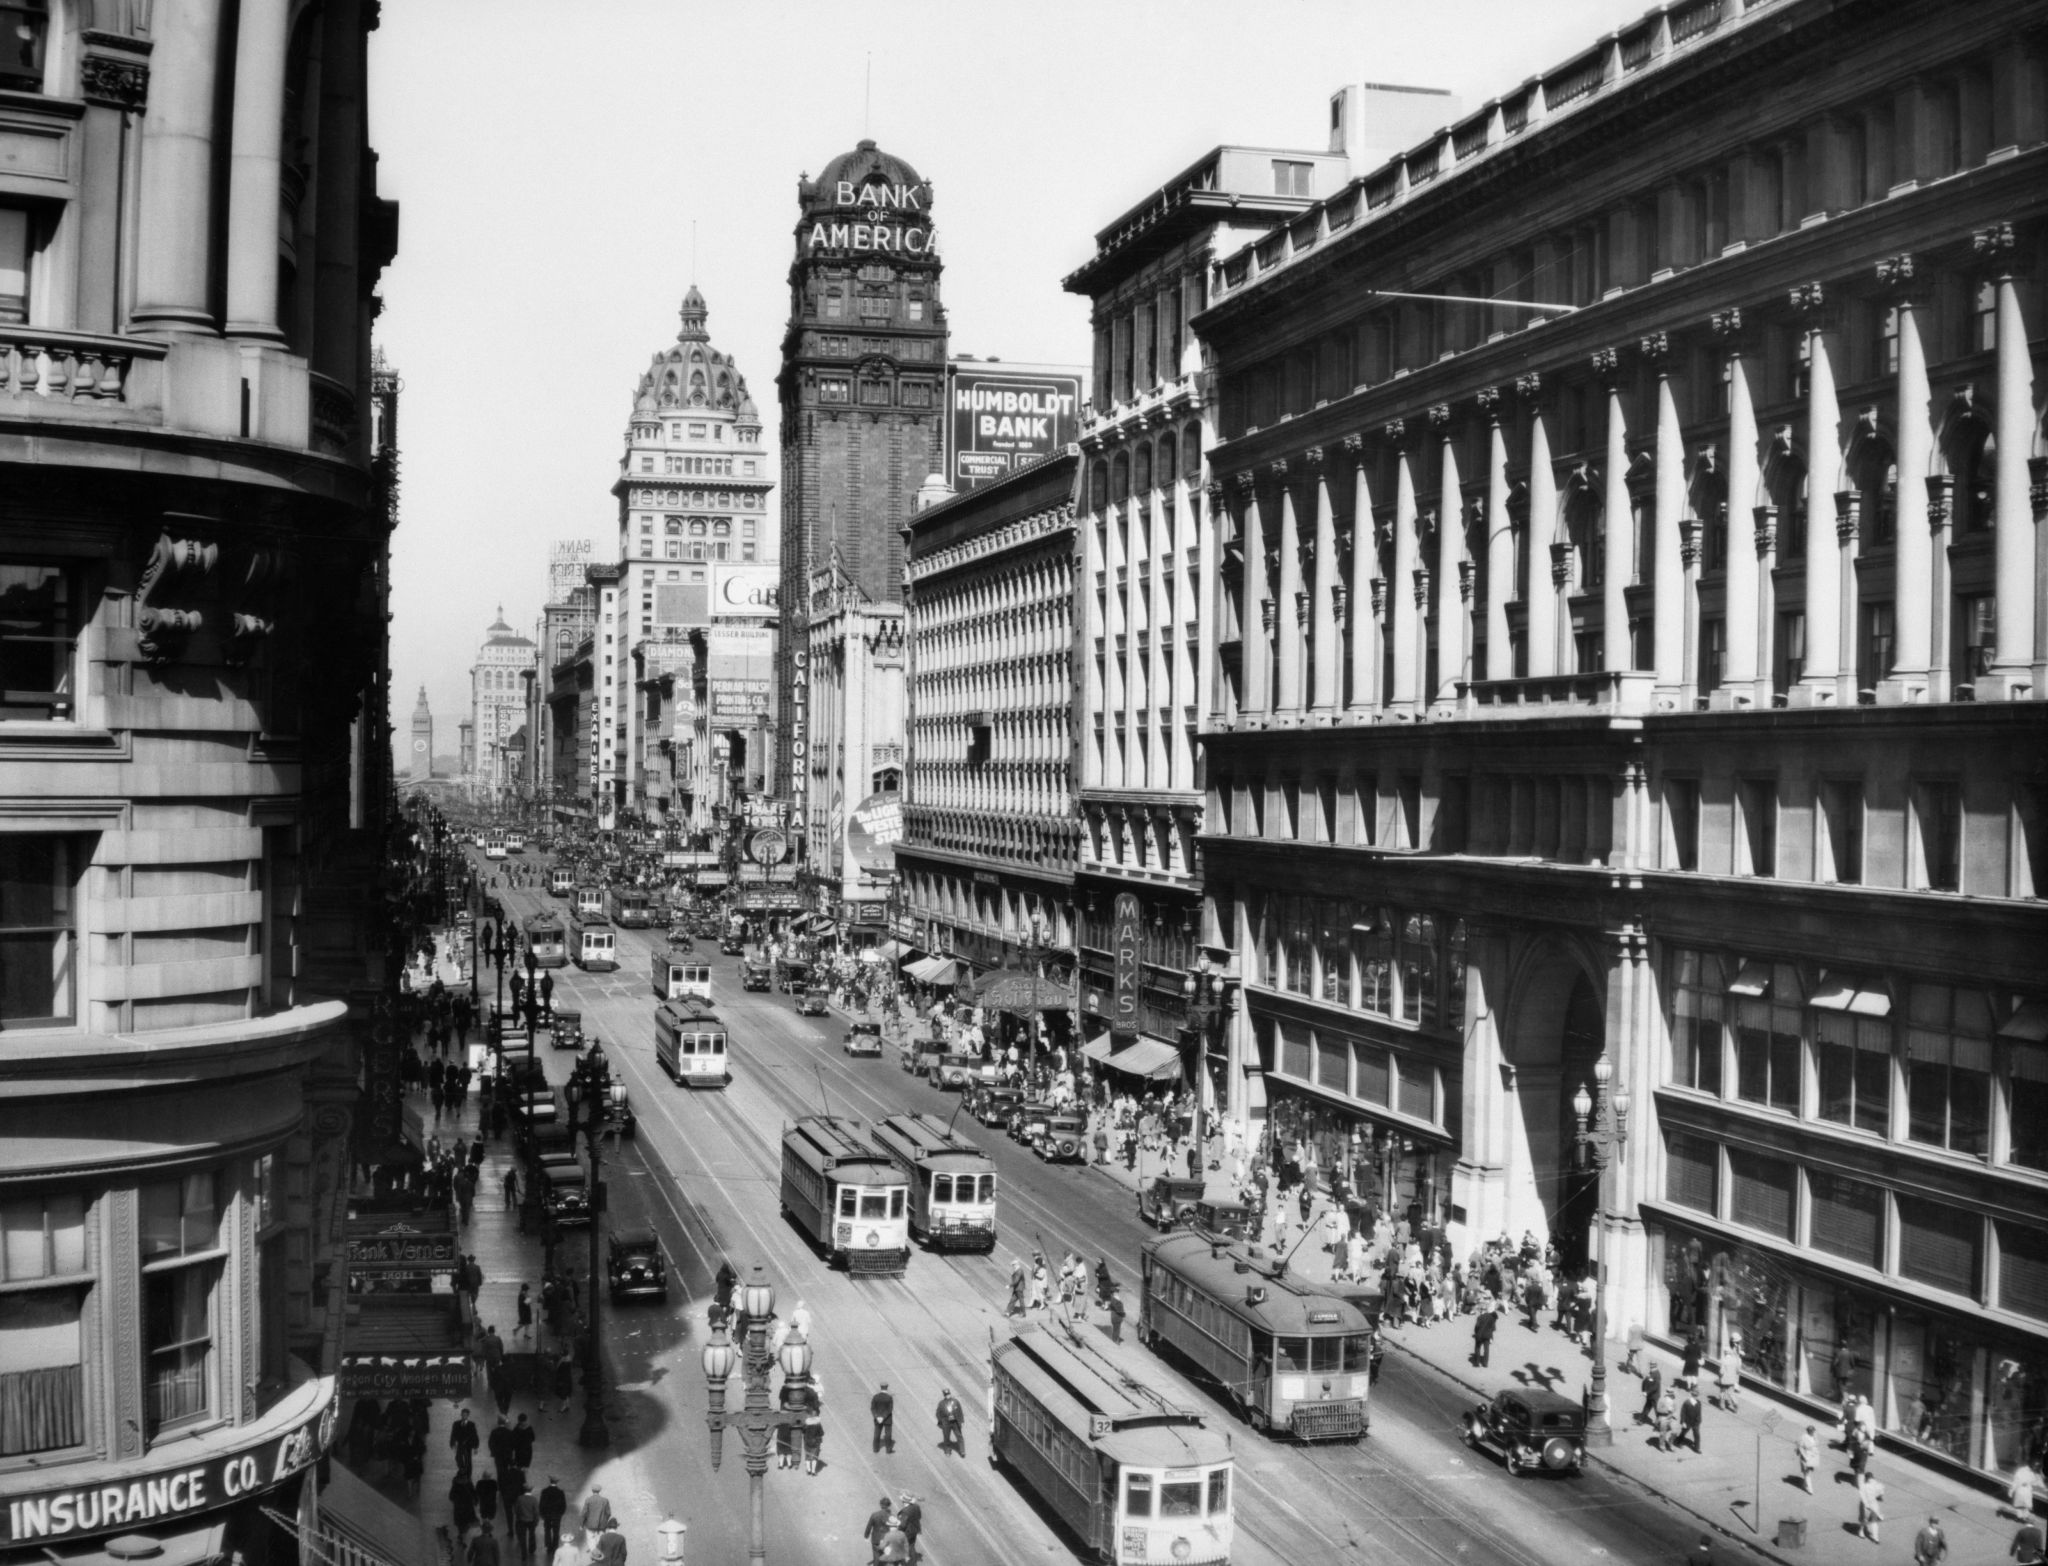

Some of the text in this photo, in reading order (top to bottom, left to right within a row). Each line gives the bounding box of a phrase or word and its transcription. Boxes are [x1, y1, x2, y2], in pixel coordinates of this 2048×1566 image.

[836, 181, 920, 209] BANK
[867, 210, 890, 222] OF
[808, 222, 940, 253] AMERICA
[957, 389, 1074, 416] HUMBOLDT
[980, 415, 1049, 439] BANK
[960, 455, 1007, 465] COMMERCIAL
[968, 464, 1000, 475] TRUST
[590, 702, 599, 785] EXAMINER
[793, 651, 807, 828] CALIFORNIA
[1119, 900, 1136, 1013] MARKS
[1114, 1020, 1137, 1030] BROS
[919, 1149, 927, 1157] 7
[825, 1158, 835, 1168] 21
[1253, 1288, 1264, 1301] J
[373, 1373, 397, 1387] City
[440, 1373, 468, 1385] Mills
[1096, 1421, 1111, 1433] 32
[10, 1469, 207, 1541] INSURANCE
